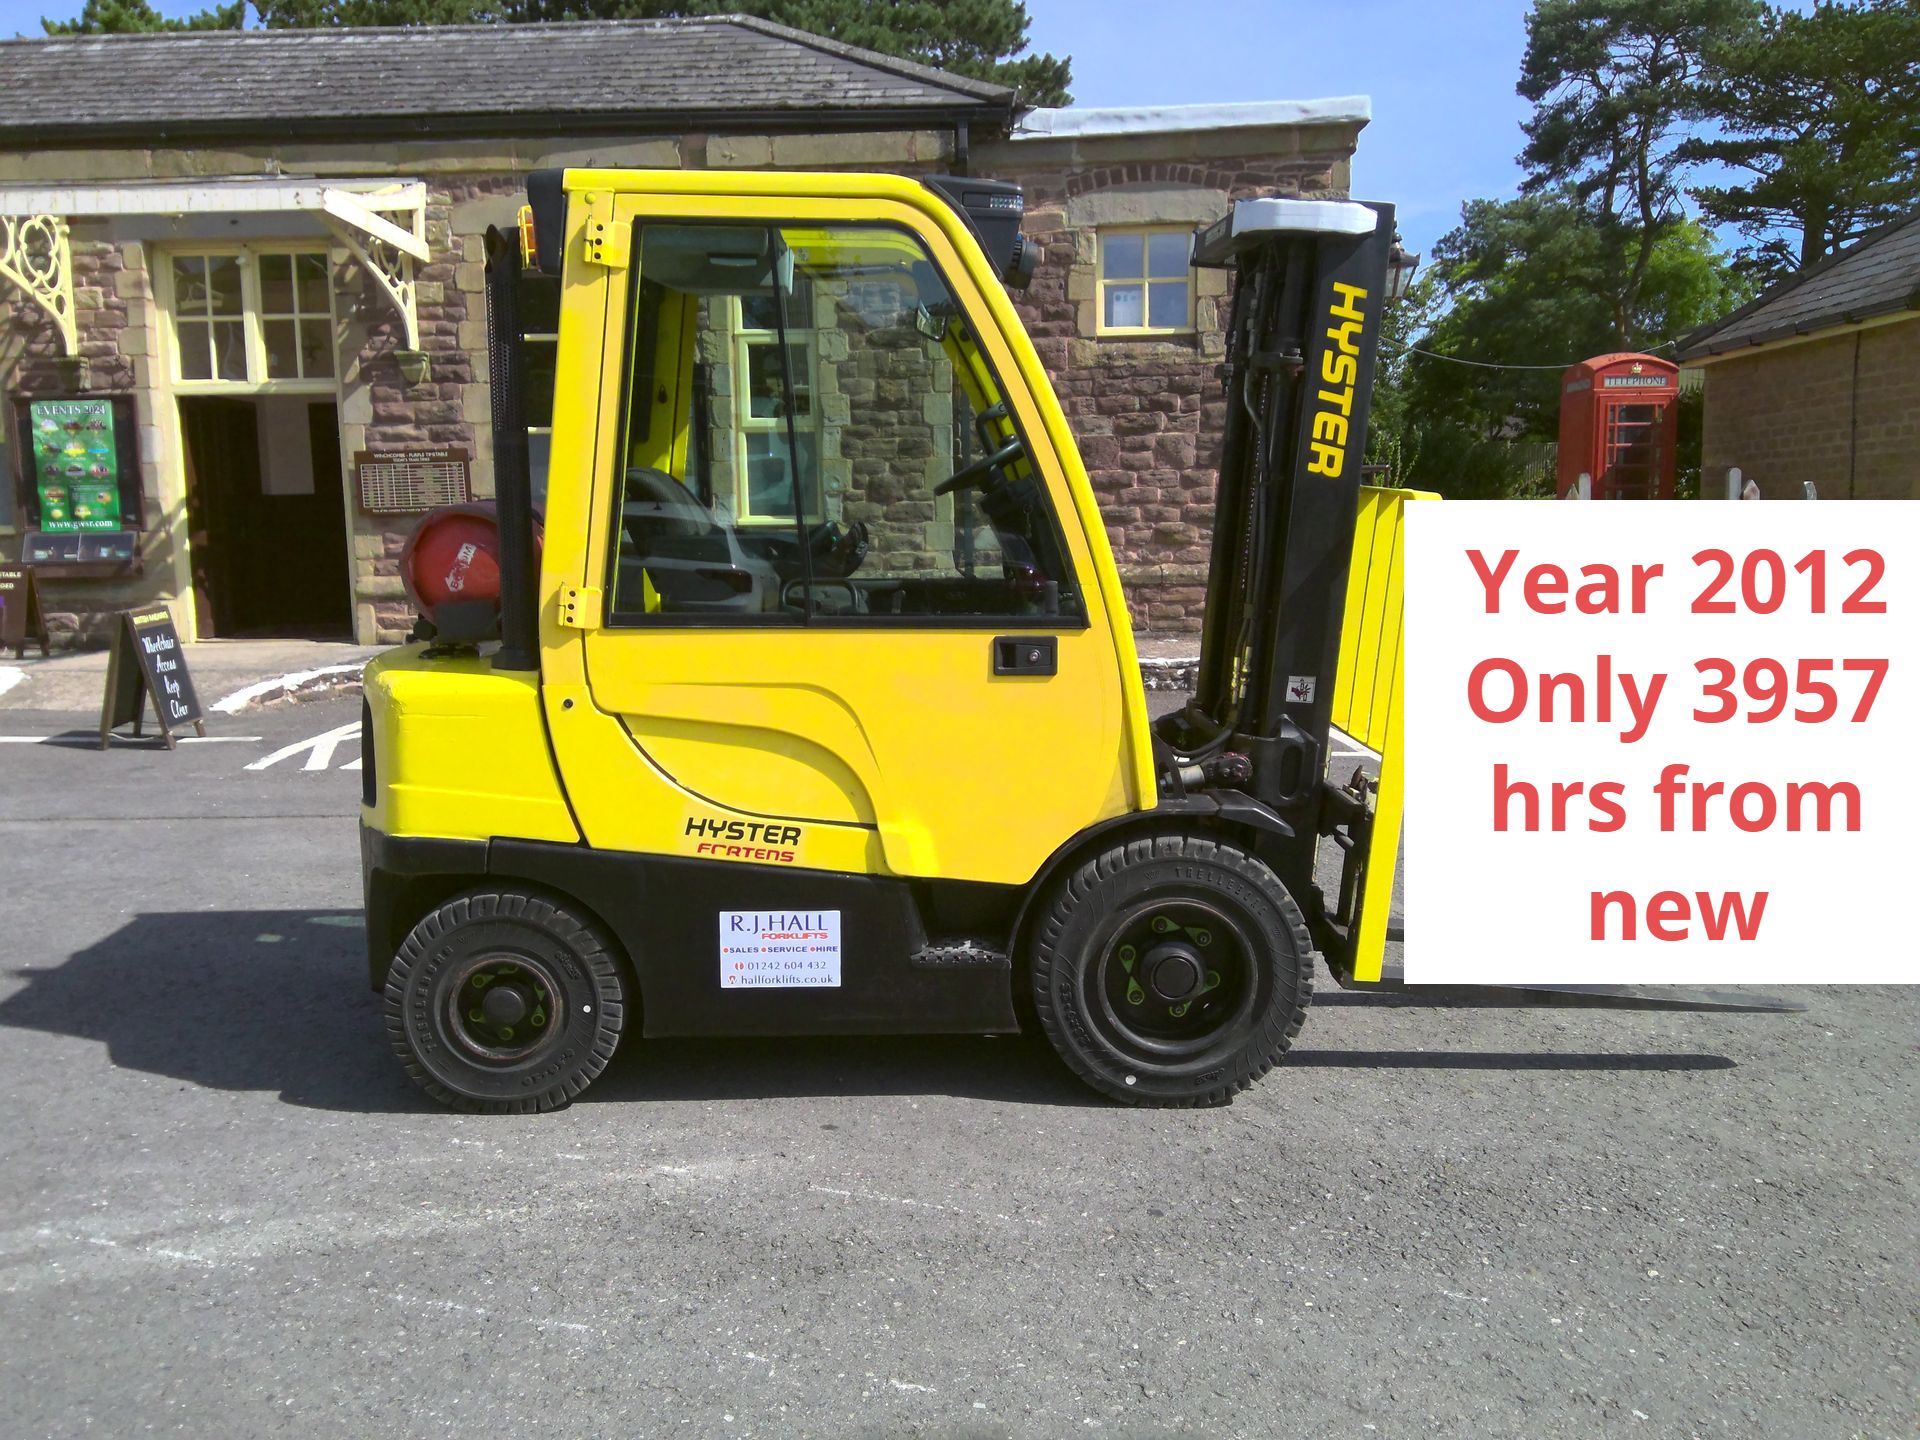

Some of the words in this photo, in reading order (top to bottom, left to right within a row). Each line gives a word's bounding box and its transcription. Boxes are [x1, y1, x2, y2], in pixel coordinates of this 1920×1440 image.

[1308, 282, 1368, 478] HYSTER
[1606, 375, 1666, 386] TELEPHONE
[37, 404, 80, 415] EVENTS
[84, 404, 105, 415] 2024
[49, 520, 113, 529] www.gwsr.com
[142, 634, 174, 654] Wheelchair
[156, 654, 177, 673] Access
[164, 675, 180, 698] Keep
[170, 699, 188, 719] Clear
[685, 817, 802, 846] HYSTER
[761, 932, 829, 940] FORKLIFTS
[816, 945, 839, 953] HIRE
[747, 961, 781, 970] 01242
[784, 961, 803, 970] 604
[807, 961, 827, 970] 432
[741, 974, 834, 985] hallforklifts.co.uk
